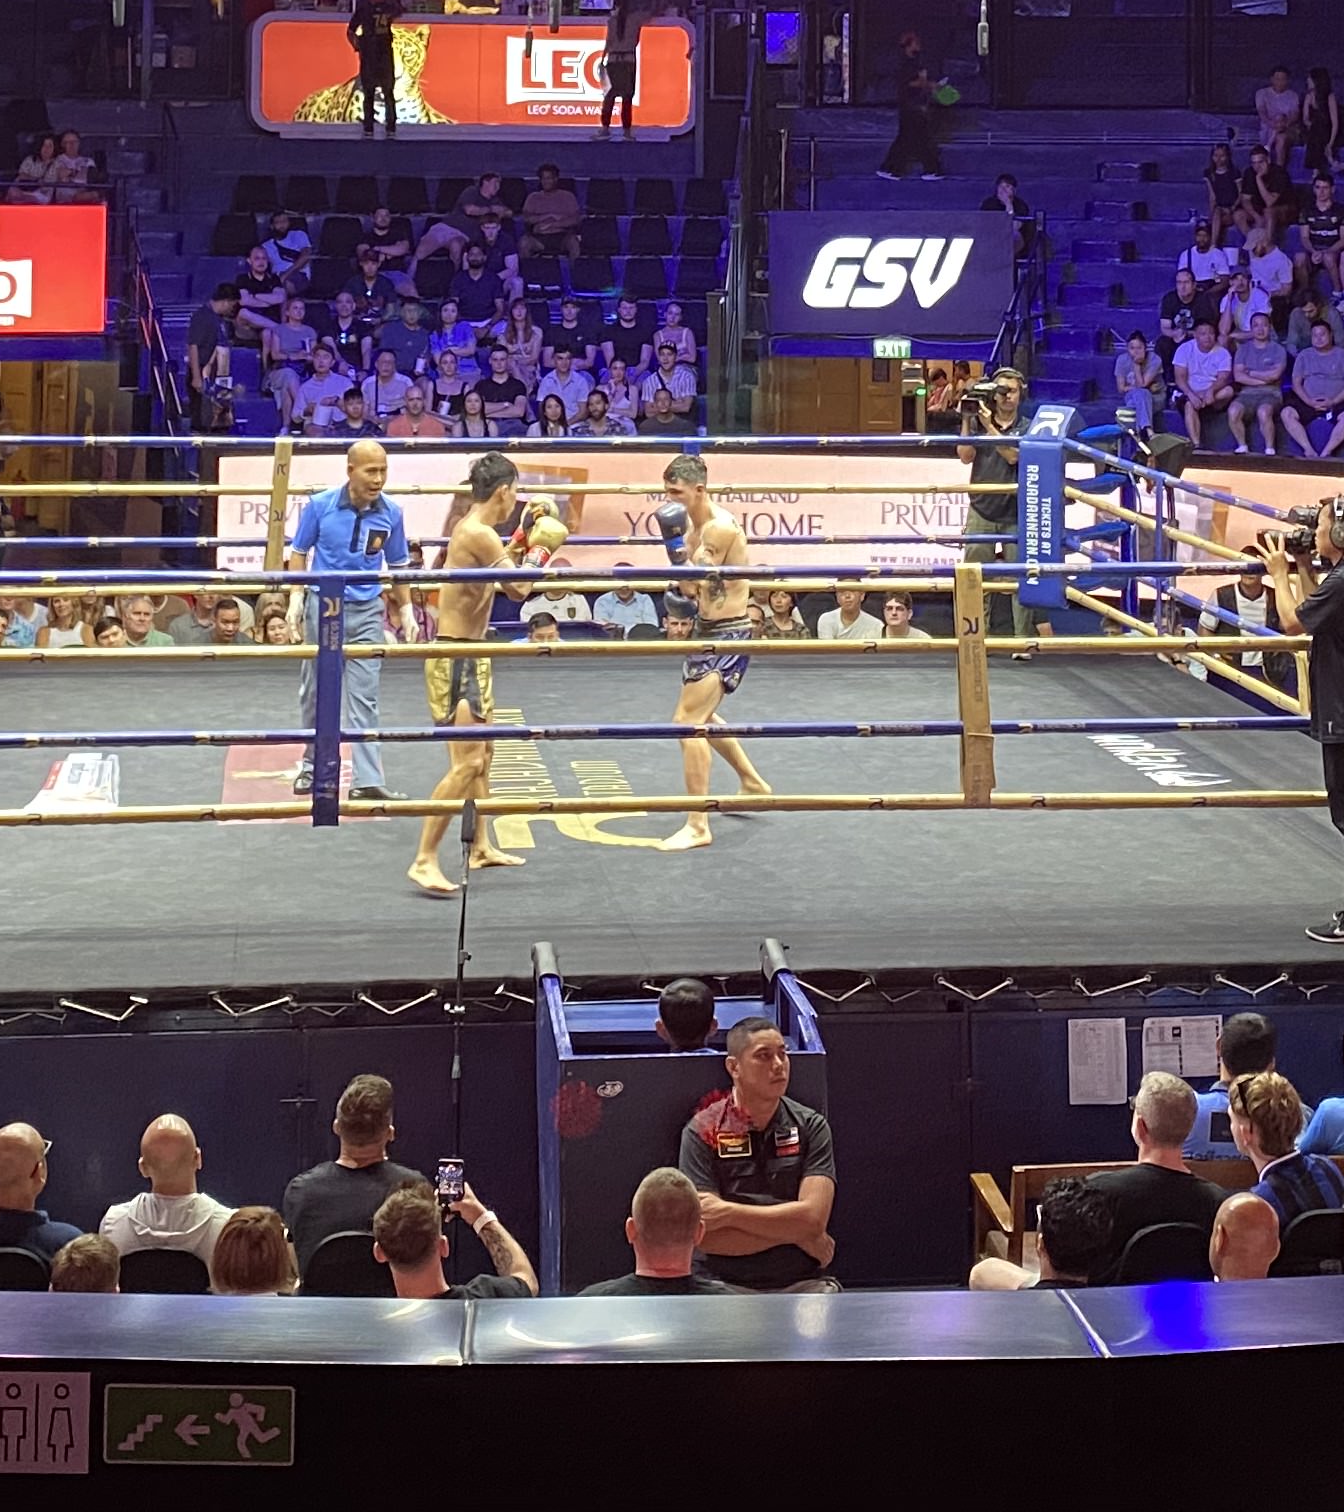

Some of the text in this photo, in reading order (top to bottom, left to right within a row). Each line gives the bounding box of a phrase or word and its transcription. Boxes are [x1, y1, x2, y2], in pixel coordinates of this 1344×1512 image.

[553, 105, 582, 116] SODA
[585, 105, 621, 117] WAR
[802, 237, 974, 309] GSV
[876, 342, 910, 358] EXIT
[1040, 497, 1052, 556] TICKETS AT
[570, 760, 636, 799] TADIUM
